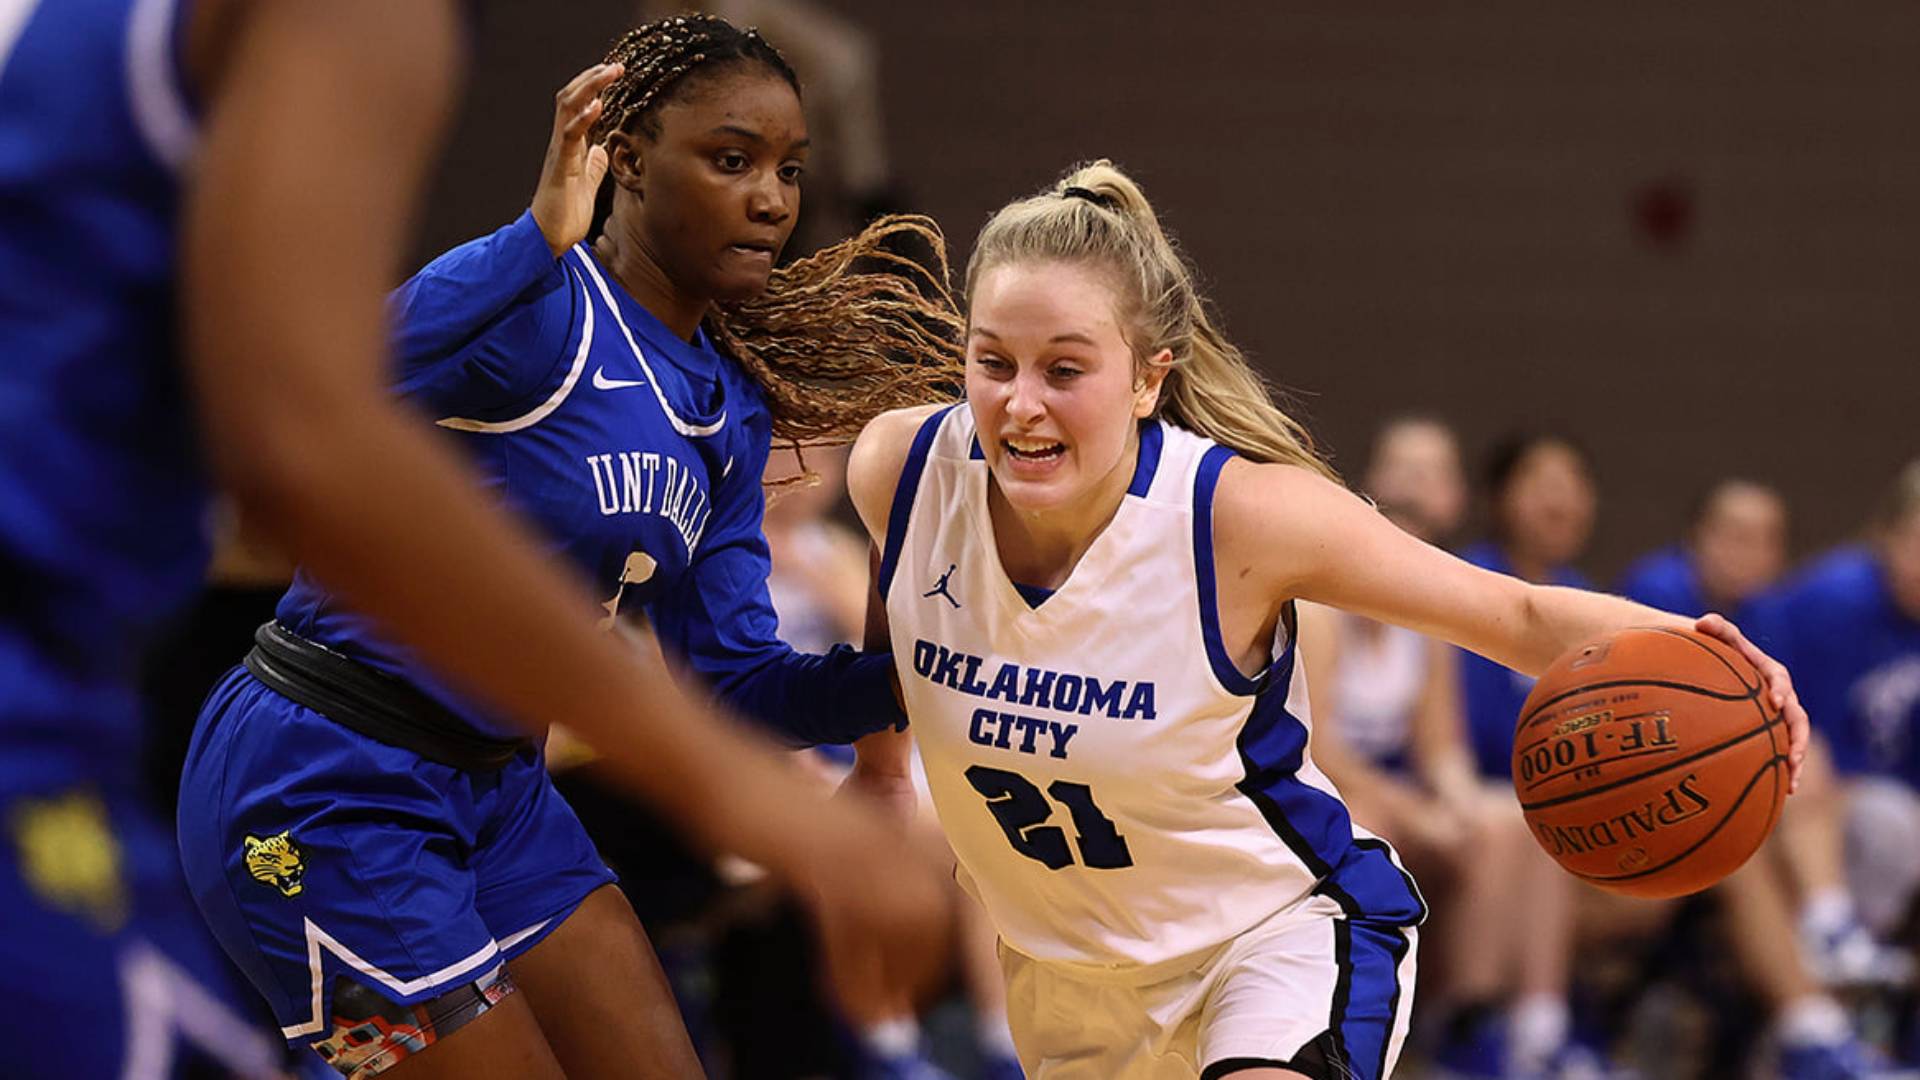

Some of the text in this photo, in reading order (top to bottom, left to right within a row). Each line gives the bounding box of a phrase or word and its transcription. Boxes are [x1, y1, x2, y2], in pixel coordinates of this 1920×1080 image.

[587, 452, 660, 515] UNT
[913, 639, 1157, 720] OKLAHOMA
[969, 708, 1079, 760] CITY
[1520, 716, 1678, 782] TF-1000
[964, 765, 1134, 870] 21
[1538, 774, 1710, 856] SPALDING
